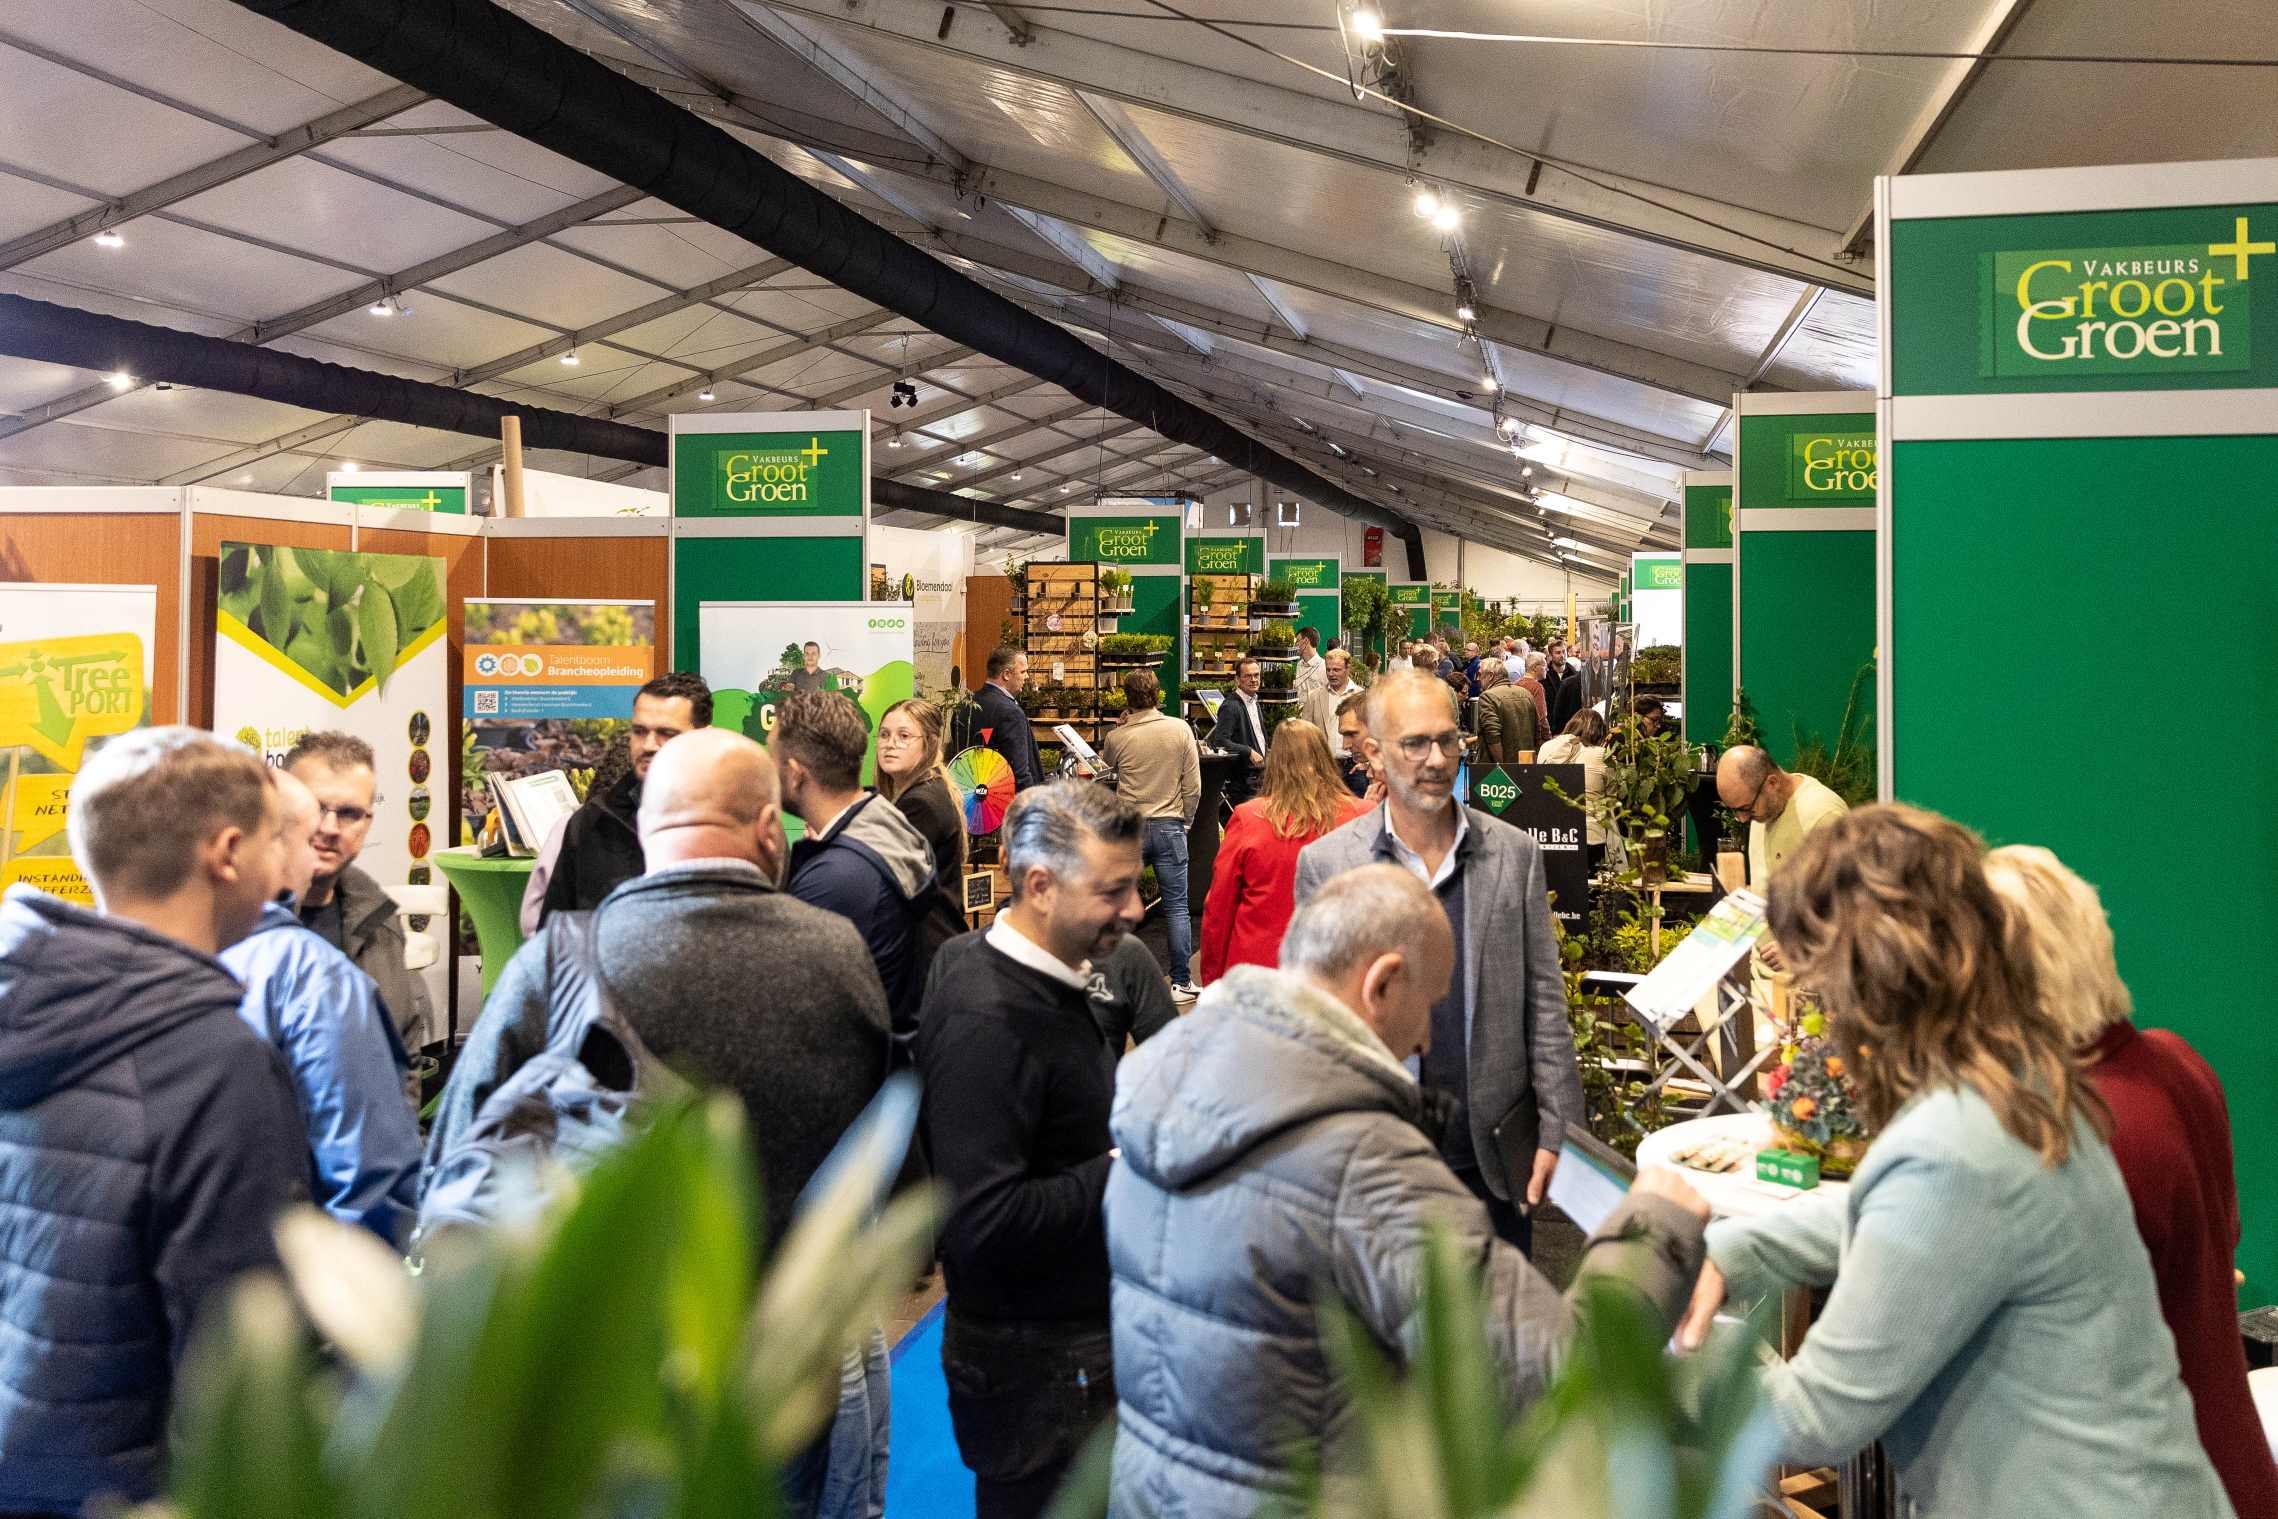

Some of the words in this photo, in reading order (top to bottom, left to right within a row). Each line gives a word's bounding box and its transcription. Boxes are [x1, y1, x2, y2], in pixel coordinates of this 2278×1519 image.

[2083, 259, 2199, 276] VAKBEURS
[2016, 259, 2225, 320] Groot
[2016, 300, 2225, 361] Groen
[1837, 439, 1877, 448] VAKBE
[752, 455, 800, 463] VAKBEURS
[1804, 438, 1877, 470] Gro
[726, 454, 809, 483] Groot
[726, 473, 809, 502] Groen
[1099, 529, 1148, 546] Groot
[1099, 540, 1148, 557] Groen
[62, 662, 130, 692] Tree
[547, 665, 644, 679] Brancheopleiding
[70, 687, 133, 715] PORT
[1480, 783, 1517, 799] B025
[1551, 827, 1579, 843] B&C
[18, 873, 88, 883] INSTAND
